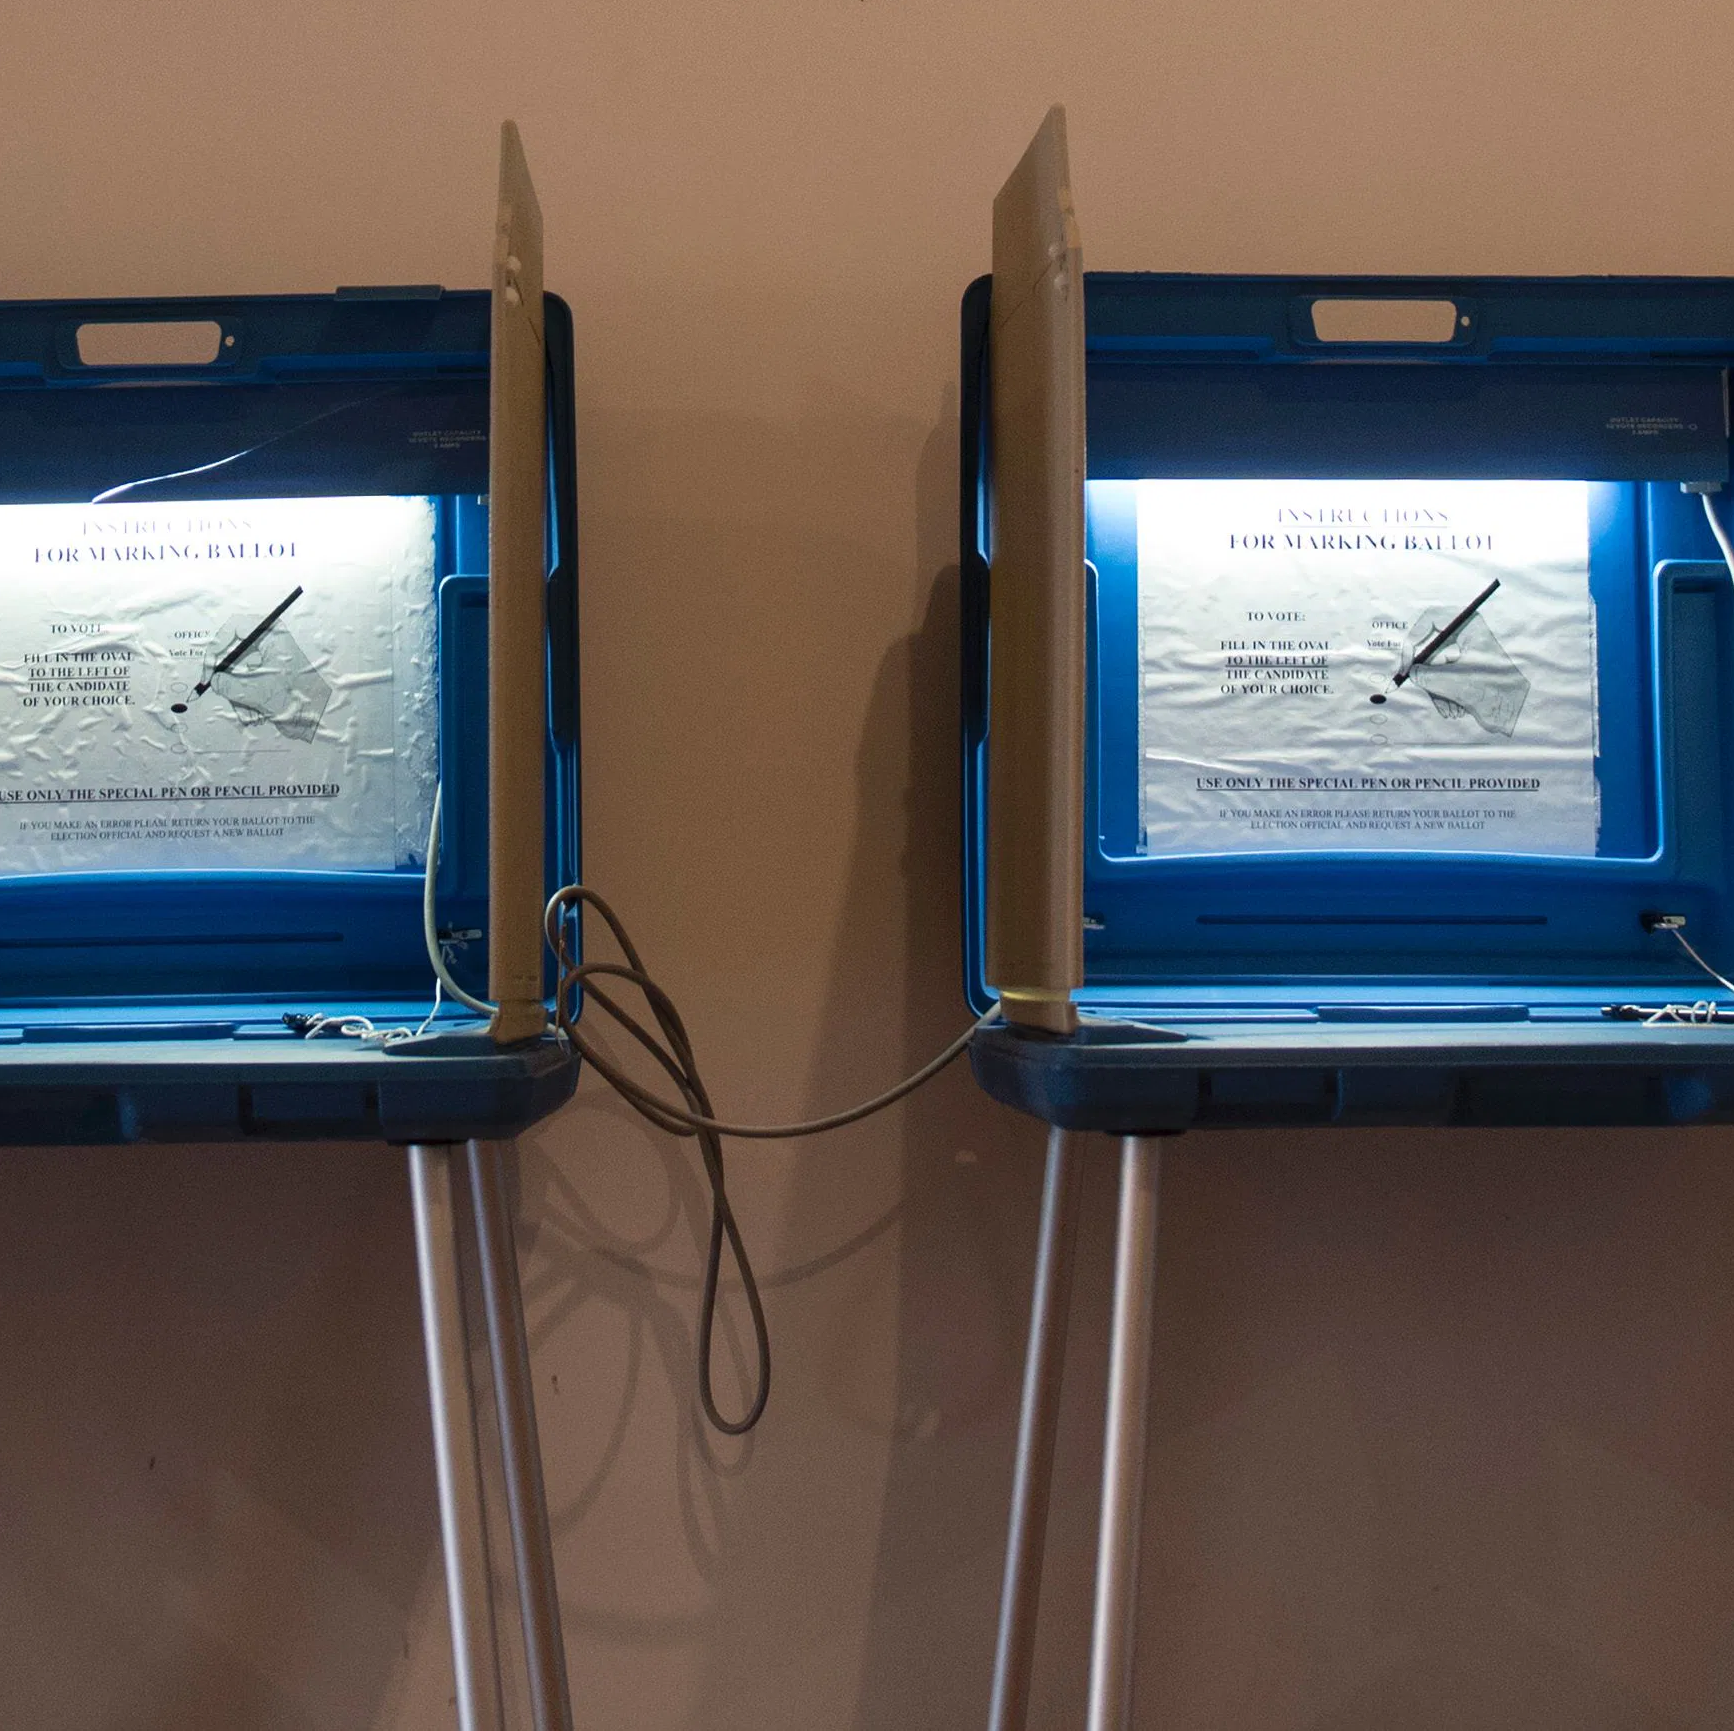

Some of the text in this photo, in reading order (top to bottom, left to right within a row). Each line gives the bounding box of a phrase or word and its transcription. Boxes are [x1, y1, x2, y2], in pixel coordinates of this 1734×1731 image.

[1278, 509, 1449, 522] INSTRUCTIONS
[1230, 534, 1492, 550] FOR MARKING BALLOT
[35, 543, 295, 563] FOR MARKING BALLOT
[1248, 612, 1305, 622] TO VOTE:
[1372, 622, 1409, 630] OFFICE
[1221, 641, 1331, 650] FILL IN THE OVAL
[56, 654, 68, 662] IN
[71, 653, 95, 662] THE
[102, 652, 134, 661] OVAL
[1226, 657, 1328, 666] TO THE LEFT OF
[29, 667, 130, 677] TO THE LEFT OF
[1226, 670, 1329, 680] THE CANDIDATE
[30, 682, 130, 692] THE CANDIDATE
[1221, 684, 1334, 694] OF YOUR CHOICE.
[23, 696, 135, 707] OF YOUR CHOICE.
[1197, 778, 1540, 789] USE ONLY THE SPECIAL PEN OR PENCIL PROVIDED
[27, 789, 67, 800] ONLY
[70, 789, 95, 800] THE
[99, 788, 156, 799] SPECIAL
[161, 787, 187, 798] PEN
[191, 786, 211, 797] OR
[215, 785, 265, 797] PENCIL
[269, 784, 340, 796] PROVIDED
